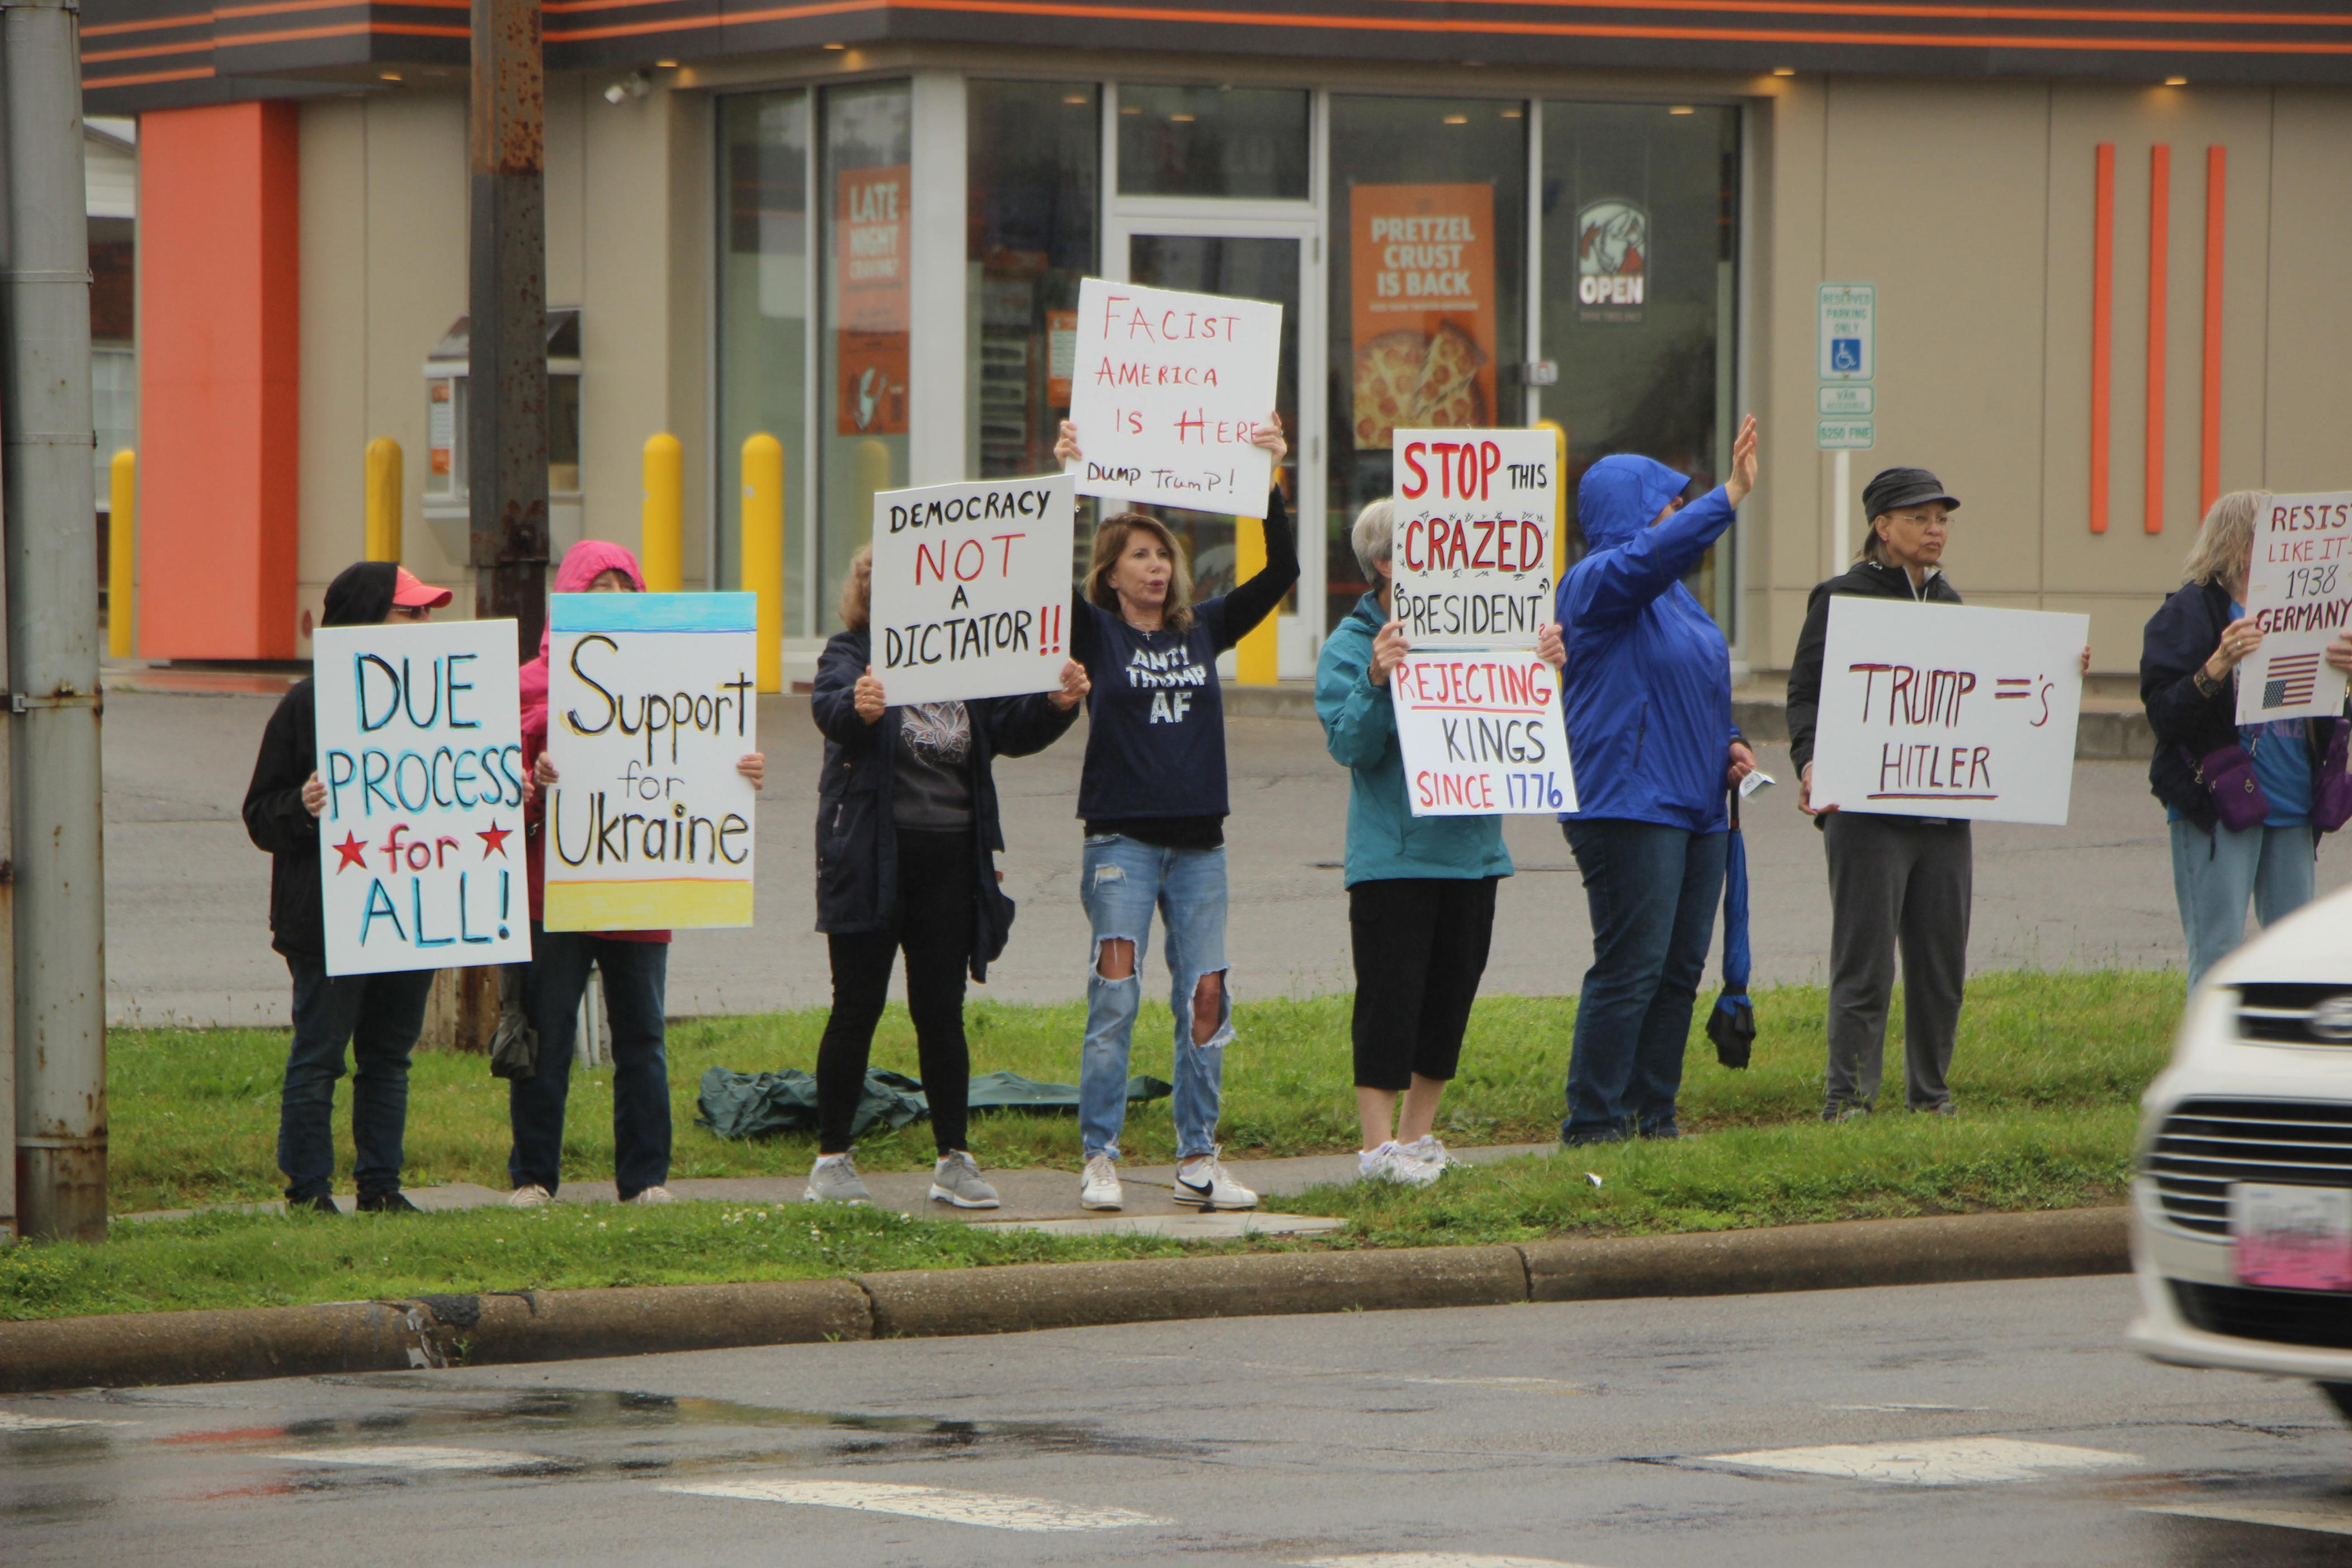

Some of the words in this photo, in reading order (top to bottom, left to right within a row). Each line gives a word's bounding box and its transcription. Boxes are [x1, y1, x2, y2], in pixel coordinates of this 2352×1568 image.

[850, 180, 899, 223] LATE
[849, 225, 899, 257] NIGHT
[1371, 216, 1475, 243] PRETZEL
[1384, 244, 1464, 268] CRUST
[1377, 272, 1401, 297] IS
[1406, 271, 1471, 297] BACK
[1579, 276, 1643, 305] OPEN
[1103, 295, 1241, 343] FACIST
[1826, 308, 1867, 319] PARKING
[1834, 323, 1859, 334] ONLY
[1094, 356, 1218, 389] AMERICA
[1117, 409, 1144, 434] IS
[1174, 407, 1260, 445] HERE
[1402, 441, 1501, 501] STOP
[1507, 464, 1547, 489] THIS
[890, 491, 1051, 534] DEMOCRACY
[2271, 505, 2352, 532] RESIS
[915, 533, 1026, 585] NOT
[1405, 517, 1544, 573] CRAZED
[2268, 540, 2314, 563] LIKE
[951, 585, 969, 610] A
[2285, 564, 2339, 599] 1938
[2255, 598, 2352, 634] GERMANY
[1126, 665, 1207, 688] TRUMP
[1131, 645, 1189, 672] ANTI
[355, 652, 481, 734] DUE
[560, 632, 754, 767] Support
[1395, 662, 1552, 706] REJECTING
[1849, 663, 1976, 729] TRUMP
[1149, 692, 1192, 724] AF
[1442, 717, 1546, 764] KINGS
[326, 745, 523, 821] PROCESS
[617, 760, 685, 801] for
[1879, 743, 1991, 792] HITLER
[1416, 771, 1495, 809] SINCE
[1506, 771, 1564, 809] 1776
[552, 788, 749, 867] Ukraine
[379, 823, 460, 875] for
[359, 870, 509, 947] ALL!
